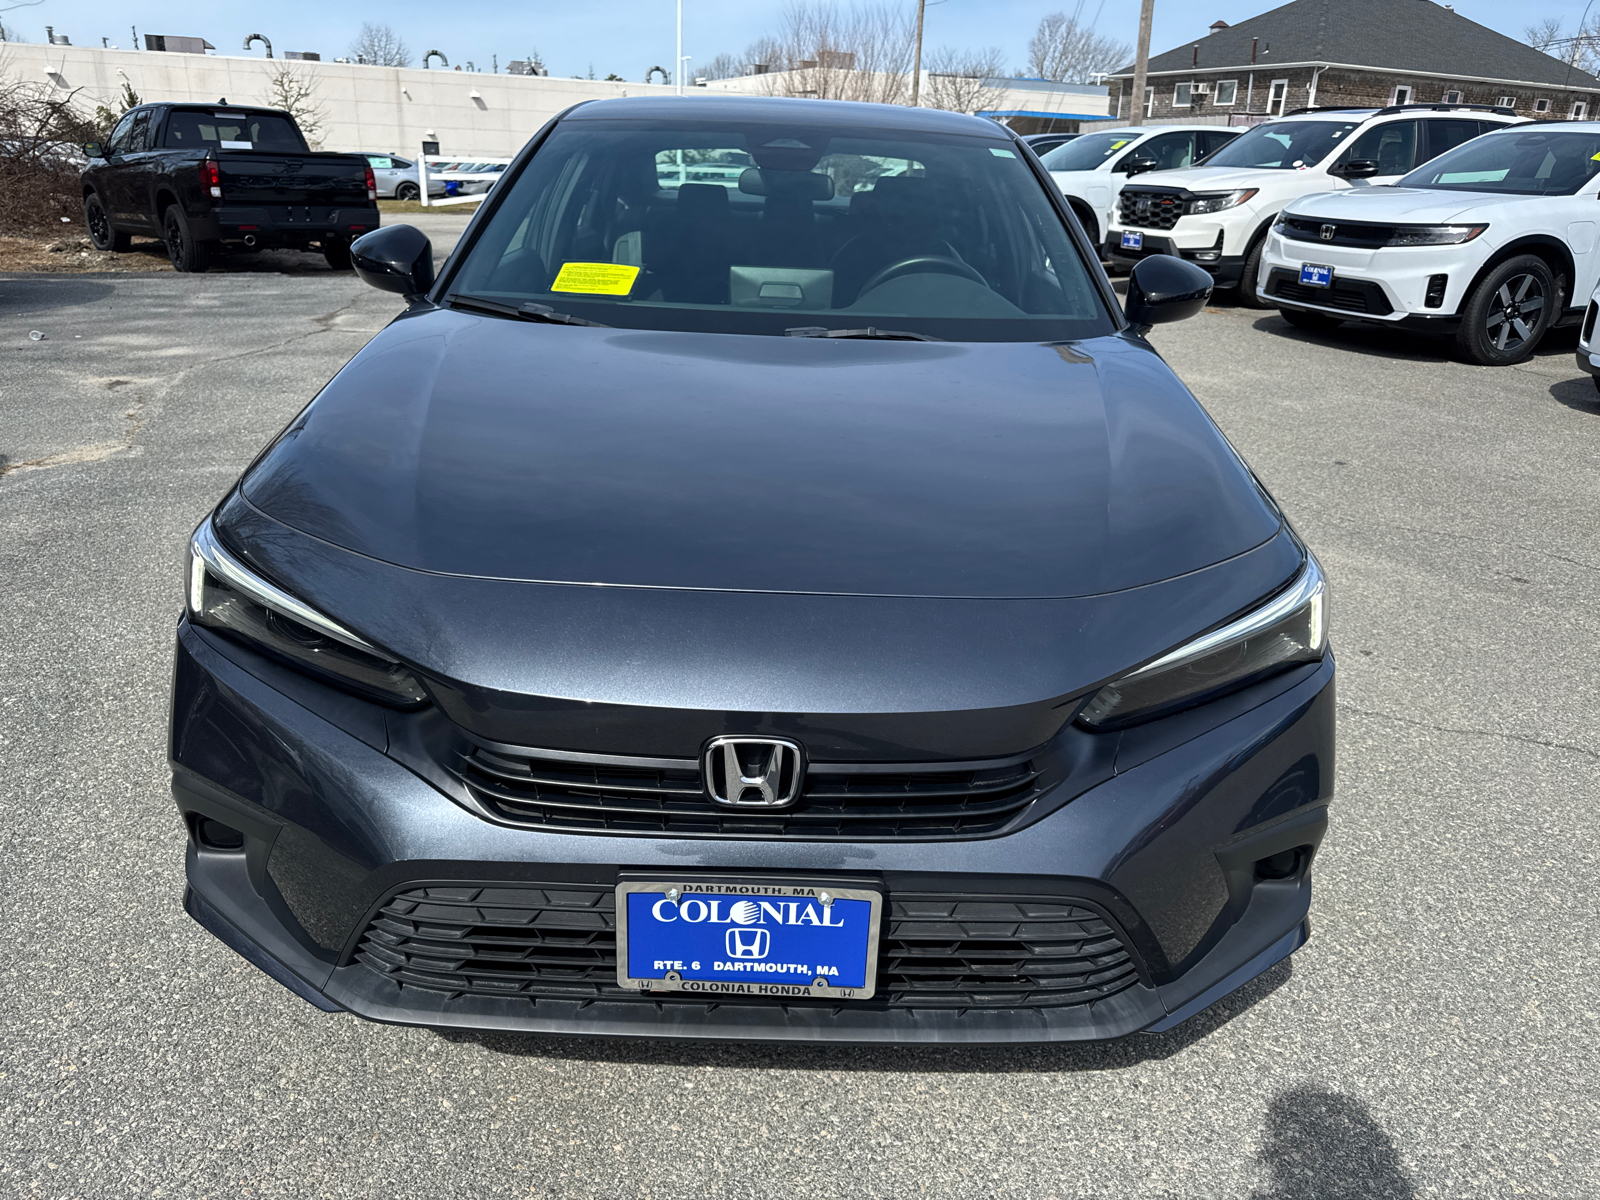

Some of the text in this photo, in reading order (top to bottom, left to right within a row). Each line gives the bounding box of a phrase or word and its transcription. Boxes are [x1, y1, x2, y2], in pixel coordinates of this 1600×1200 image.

[792, 888, 816, 896] MA
[651, 899, 844, 927] COLONIAL
[653, 960, 839, 977] RTE. 6 DARTMOUTH, MA
[681, 981, 812, 997] COLONIAL HONDA
